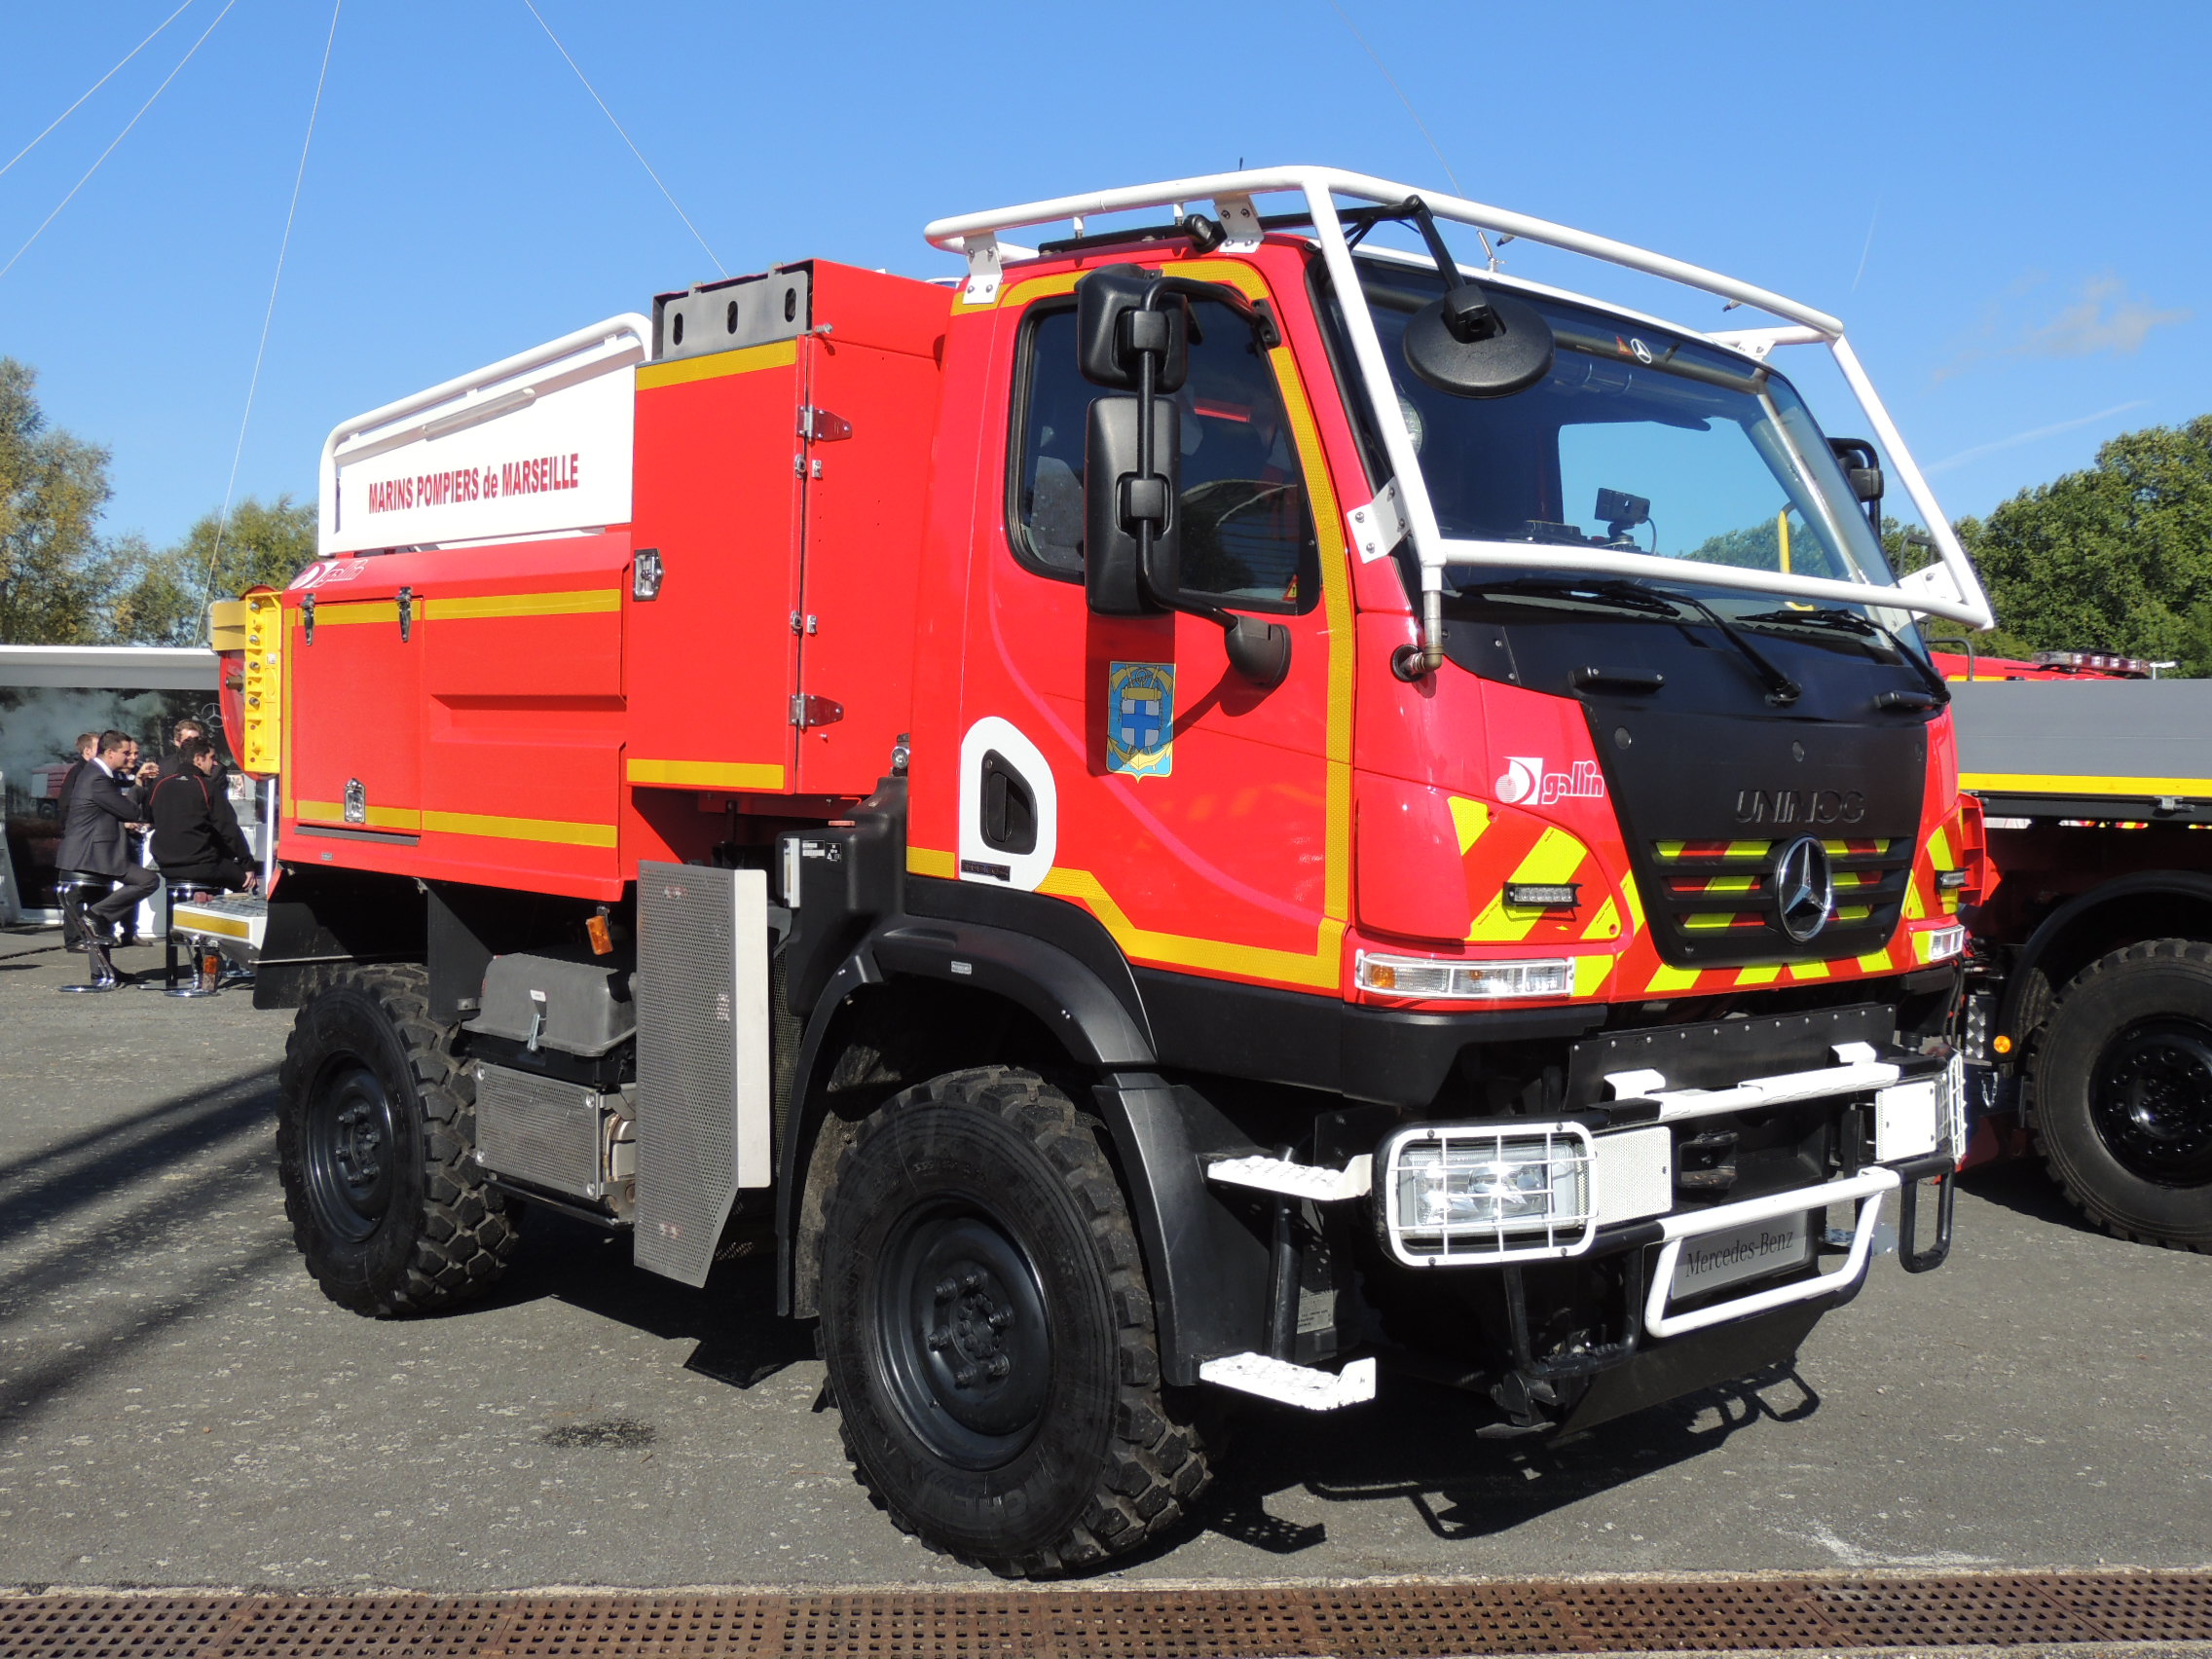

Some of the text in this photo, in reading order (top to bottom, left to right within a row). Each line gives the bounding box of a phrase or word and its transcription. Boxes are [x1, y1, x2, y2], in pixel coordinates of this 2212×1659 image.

[368, 453, 578, 514] MARINS POMPIERS de MARSEILLE
[1541, 760, 1604, 805] gallin
[1736, 790, 1864, 824] UNIMOG
[1685, 1232, 1793, 1278] Mercedes-Benz
